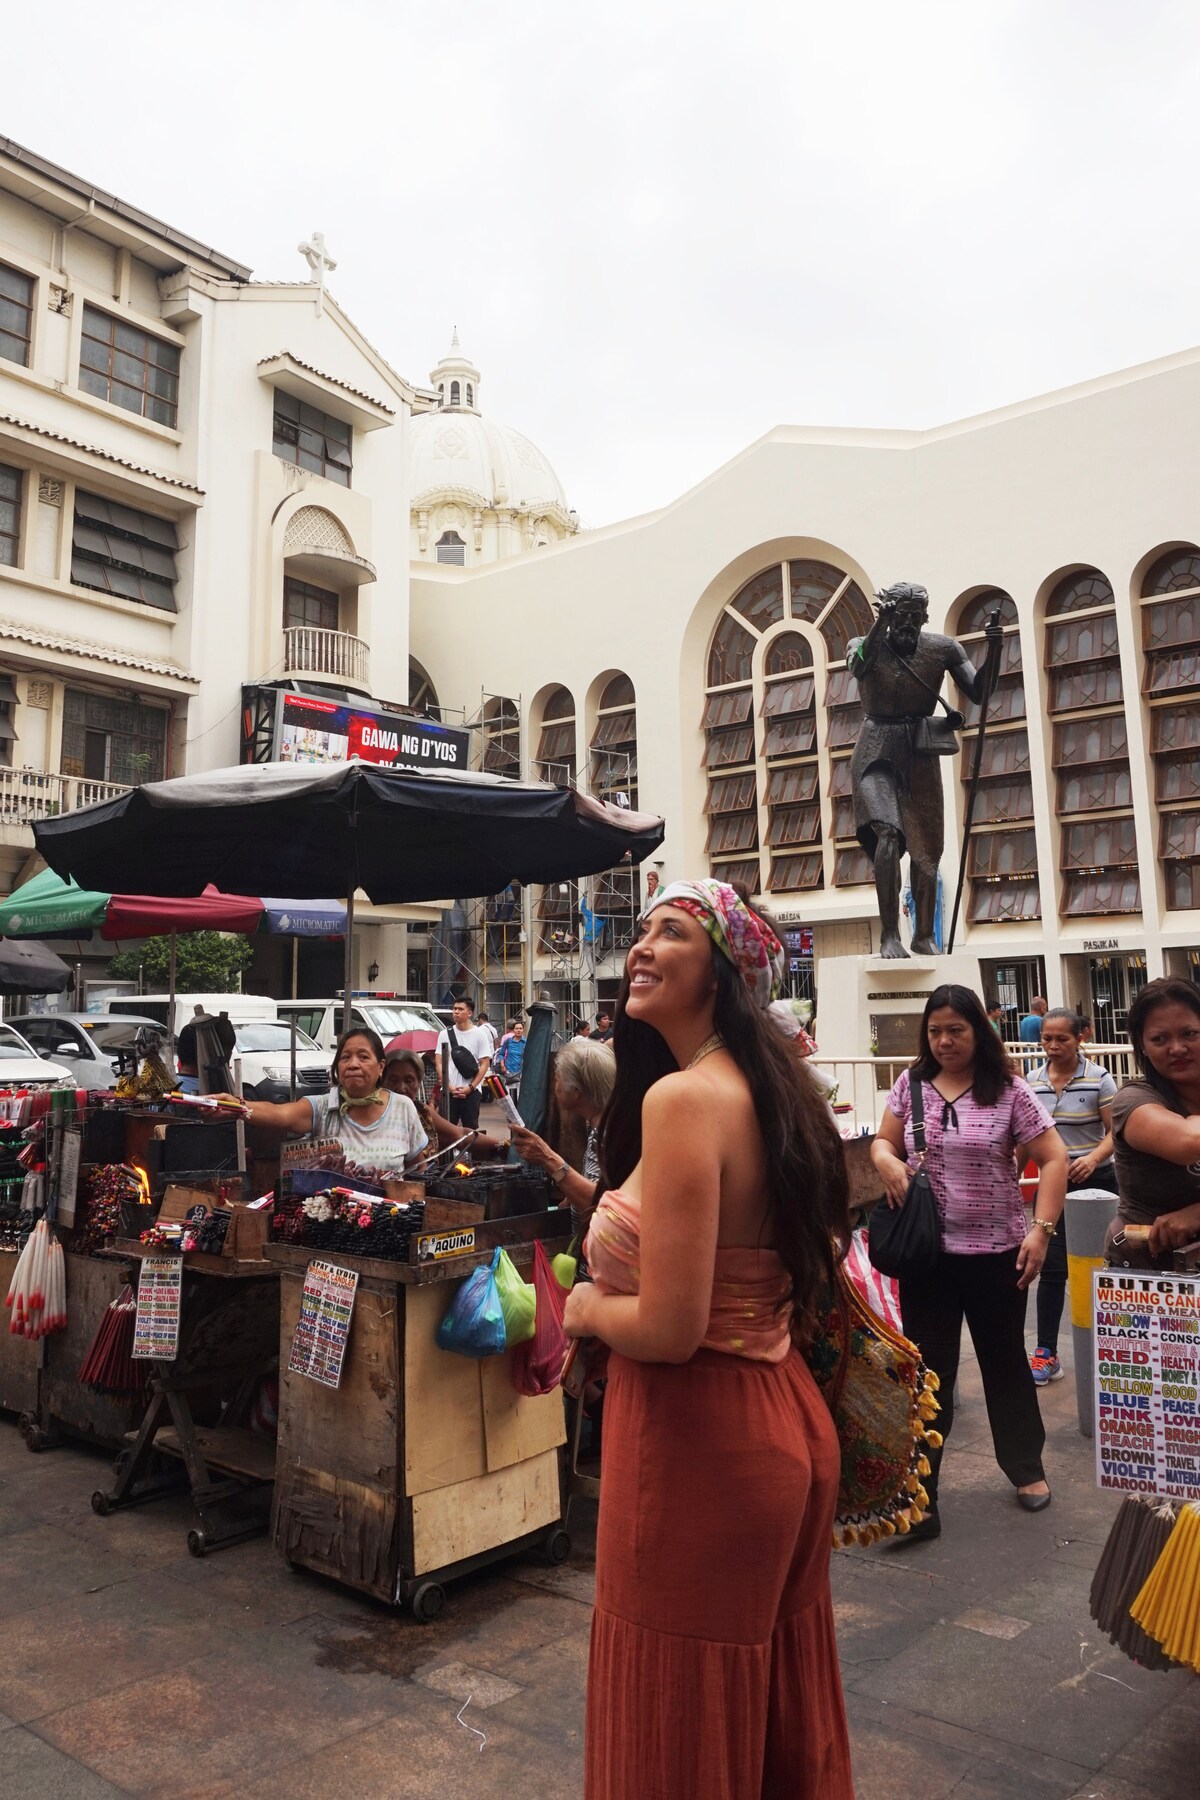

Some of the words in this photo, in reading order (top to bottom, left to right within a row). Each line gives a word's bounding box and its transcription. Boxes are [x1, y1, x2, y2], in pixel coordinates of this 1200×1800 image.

[361, 726, 398, 751] GAWA
[401, 734, 419, 755] NG
[25, 910, 89, 926] MICROMATIC
[292, 918, 340, 930] MICROMATIC
[431, 1237, 436, 1245] 9
[434, 1234, 473, 1253] AQUINO
[309, 1266, 329, 1278] WISHING
[331, 1274, 355, 1288] CANDLES
[313, 1260, 328, 1271] EPAY
[336, 1269, 355, 1279] LYDIA
[304, 1286, 321, 1297] RED
[1099, 1277, 1194, 1295] BUTCH
[1097, 1288, 1160, 1305] WISHING
[300, 1308, 318, 1319] BLUE
[1100, 1301, 1153, 1314] COLORS
[1157, 1306, 1166, 1315] &
[1169, 1307, 1200, 1318] MEA
[320, 1323, 333, 1332] LOVE
[1097, 1312, 1150, 1329] RAINBOW
[1159, 1317, 1198, 1334] WISHING
[1097, 1327, 1149, 1340] BLACK
[1160, 1333, 1200, 1345] CONSC
[1097, 1337, 1151, 1352] WHITE
[1161, 1343, 1187, 1357] WISH
[1190, 1345, 1198, 1358] &
[289, 1363, 308, 1374] BLACK
[1098, 1348, 1149, 1365] RED
[1161, 1356, 1195, 1371] HEALTH
[1098, 1362, 1152, 1380] GREEN
[1161, 1369, 1189, 1384] MONEY
[1191, 1372, 1197, 1385] &
[1099, 1377, 1153, 1396] YELLOW
[1162, 1384, 1197, 1401] GOOD
[1099, 1392, 1150, 1409] BLUE
[1162, 1399, 1195, 1414] PEACE
[1099, 1406, 1152, 1423] PINK
[1164, 1413, 1200, 1428] LOVE
[1099, 1418, 1154, 1437] ORANGE
[1164, 1426, 1200, 1444] BRIGH
[1100, 1433, 1154, 1451] PEACH
[1101, 1447, 1155, 1466] BROWN
[1165, 1455, 1196, 1470] TRAVEL
[1101, 1461, 1156, 1480] VIOLET
[1101, 1475, 1157, 1493] MAROON
[1166, 1485, 1185, 1498] ALAY
